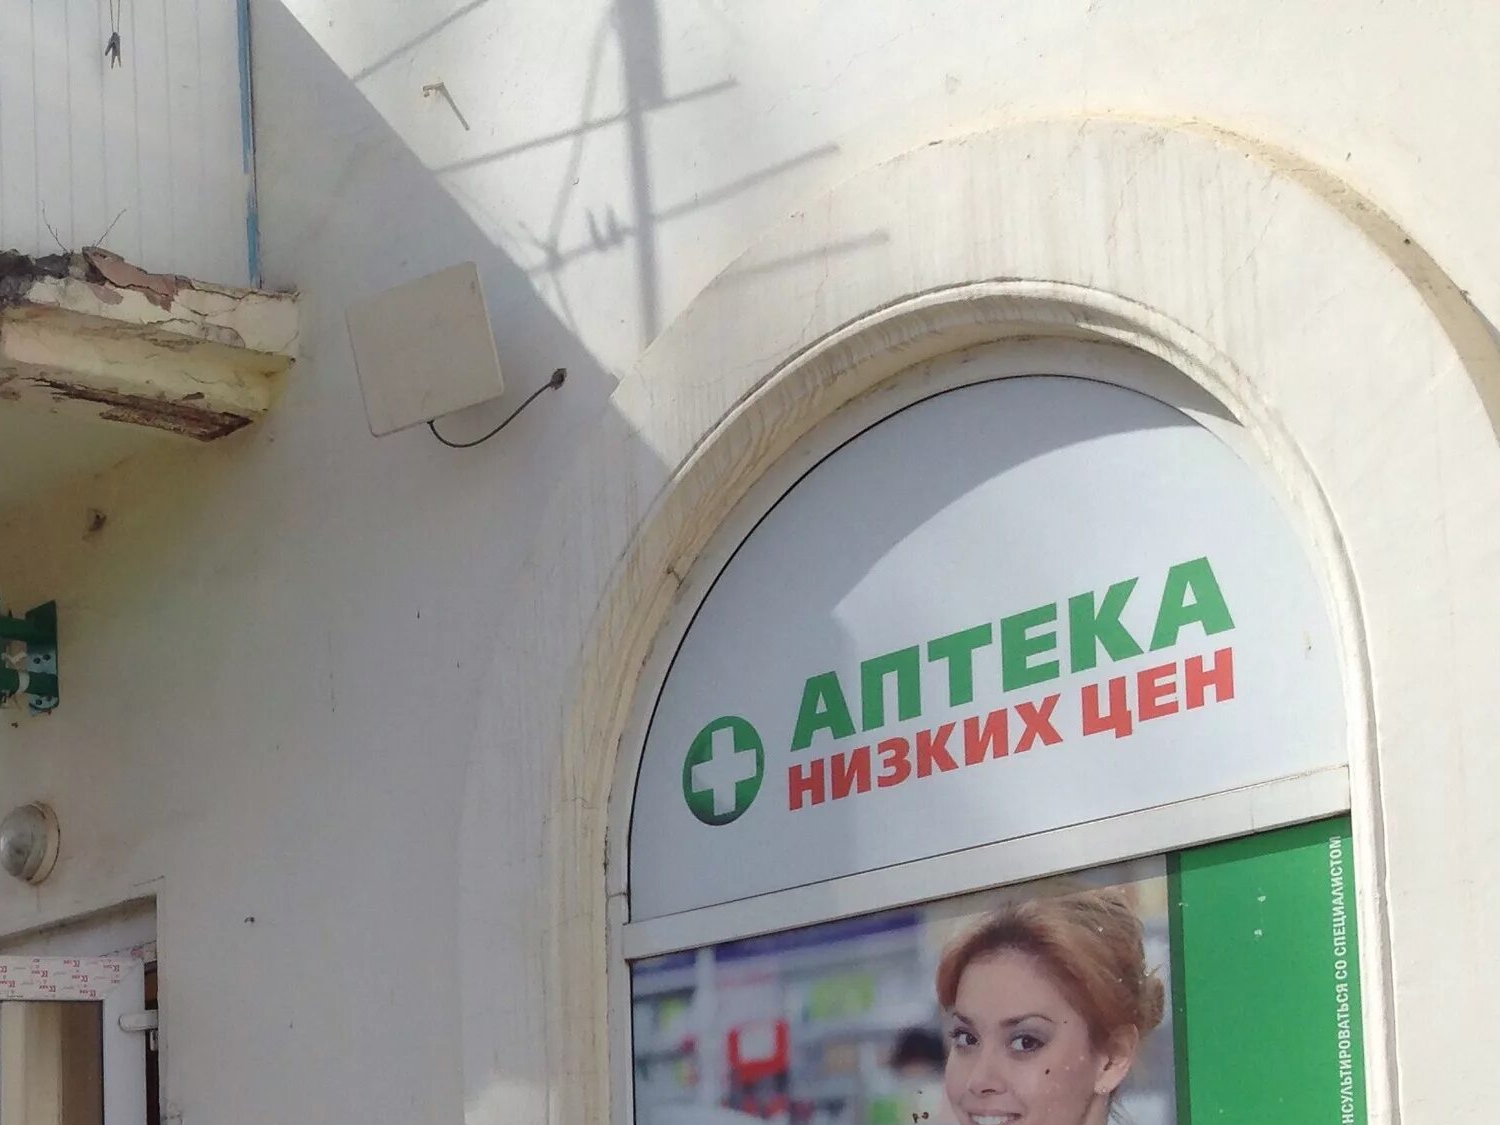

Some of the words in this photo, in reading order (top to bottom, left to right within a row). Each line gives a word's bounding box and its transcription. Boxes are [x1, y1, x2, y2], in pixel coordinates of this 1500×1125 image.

[791, 556, 1236, 752] АПТЕКА
[788, 692, 1063, 811] НИЗКИХ
[1081, 647, 1236, 739] ЦЕН
[1328, 835, 1348, 956] СПЕЦИАЛИСТОМ
[1334, 959, 1348, 980] СО
